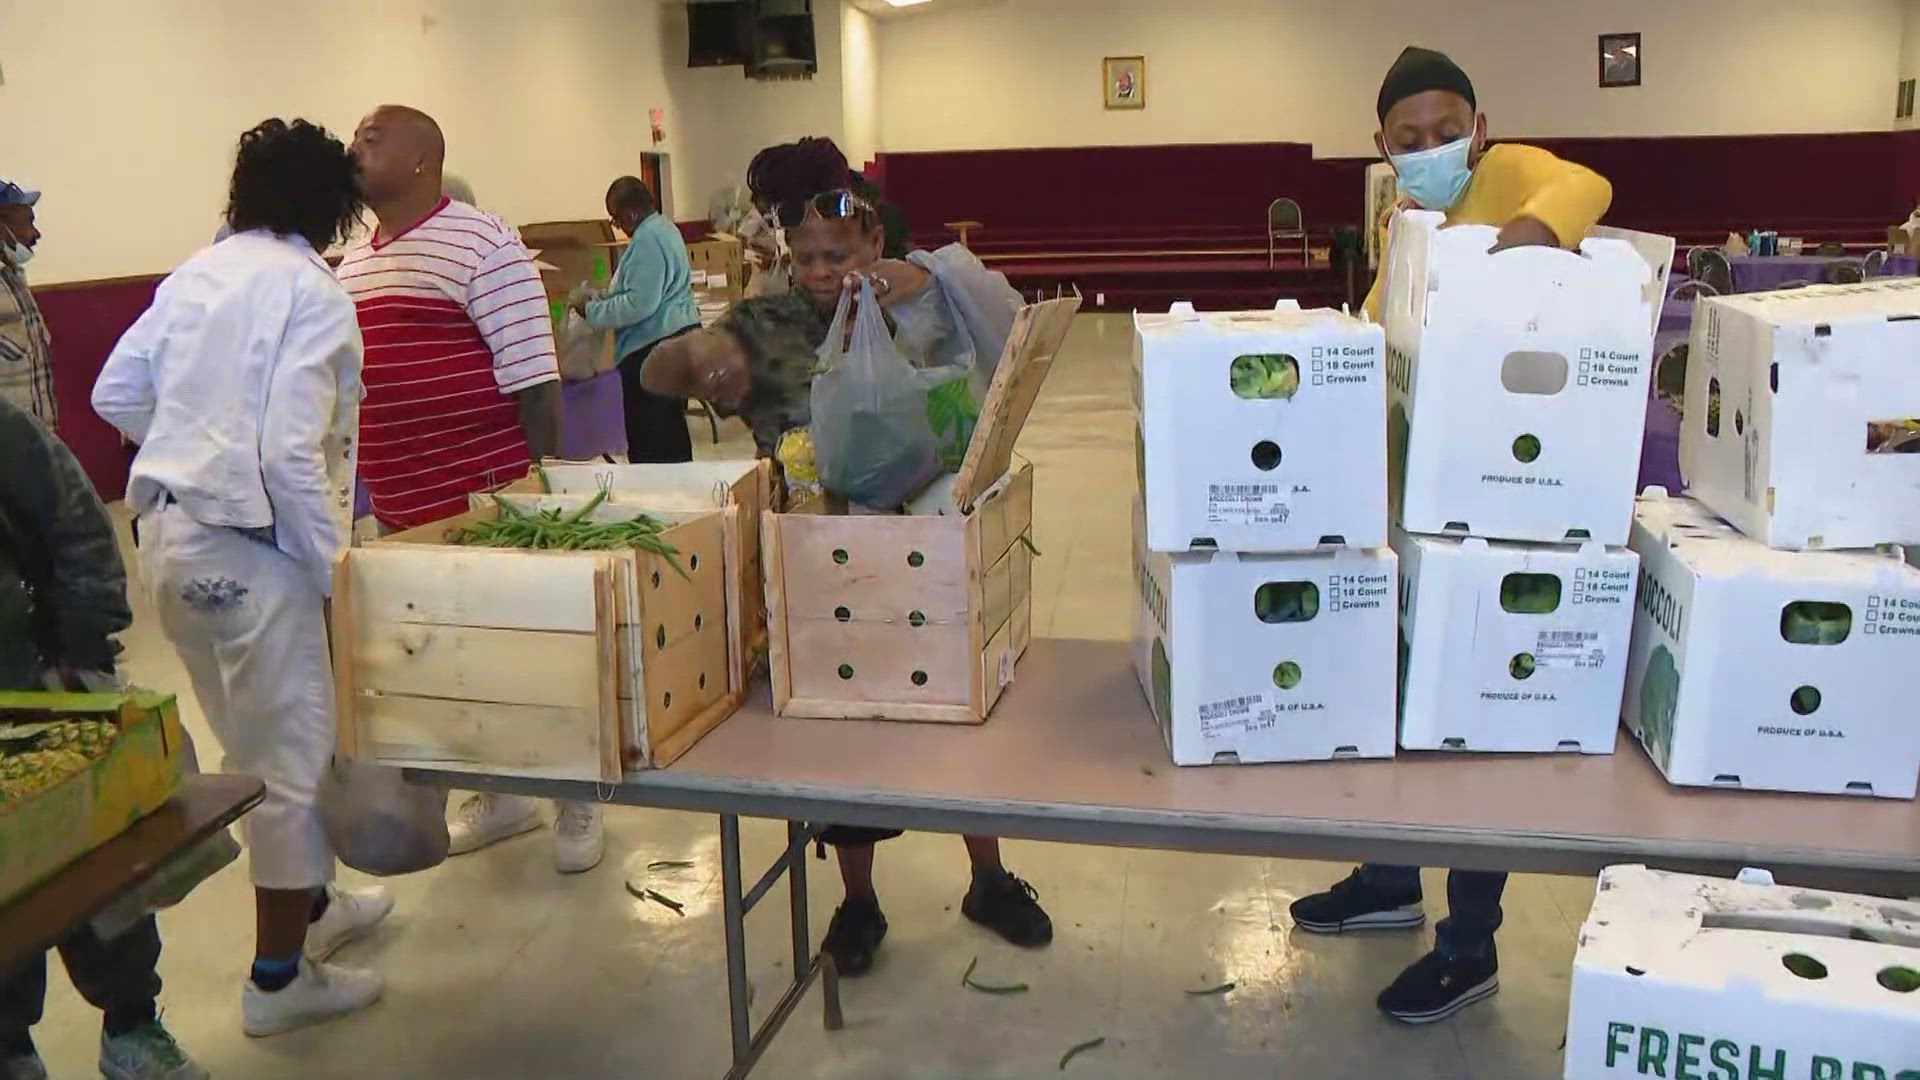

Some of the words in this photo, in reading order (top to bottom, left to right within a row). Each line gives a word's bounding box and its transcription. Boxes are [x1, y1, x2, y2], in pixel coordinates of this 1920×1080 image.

[1327, 347, 1339, 356] 14
[1342, 346, 1375, 356] Count
[1593, 350, 1606, 360] 14
[1609, 351, 1639, 362] Count
[1327, 361, 1339, 370] 18
[1342, 360, 1375, 370] Count
[1592, 363, 1605, 372] 18
[1608, 364, 1638, 375] Count
[1326, 375, 1367, 384] Crowns
[1590, 376, 1629, 387] Crowns
[1481, 474, 1522, 485] PRODUCE
[1524, 476, 1536, 485] OF
[1538, 477, 1564, 487] U.S.A.
[1291, 485, 1311, 493] .S.A.
[1343, 576, 1355, 584] 14
[1357, 574, 1388, 584] Count
[1587, 570, 1599, 578] 14
[1602, 571, 1630, 579] Count
[1343, 588, 1355, 597] 18
[1357, 587, 1388, 597] Count
[1587, 582, 1598, 591] 18
[1600, 583, 1629, 592] Count
[1585, 594, 1620, 604] Crowns
[1884, 598, 1896, 608] 14
[1342, 600, 1380, 610] Crowns
[1882, 611, 1895, 621] 18
[1480, 691, 1520, 701] PRODUCE
[1521, 692, 1533, 701] OF
[1534, 692, 1558, 702] U.S.A.
[1287, 702, 1298, 712] OF
[1301, 702, 1325, 712] U.S.A.
[1757, 725, 1802, 736] PRODUCE
[1803, 728, 1816, 737] OF
[1818, 729, 1846, 739] U.S.A.
[1605, 1020, 1787, 1080] FRESH
